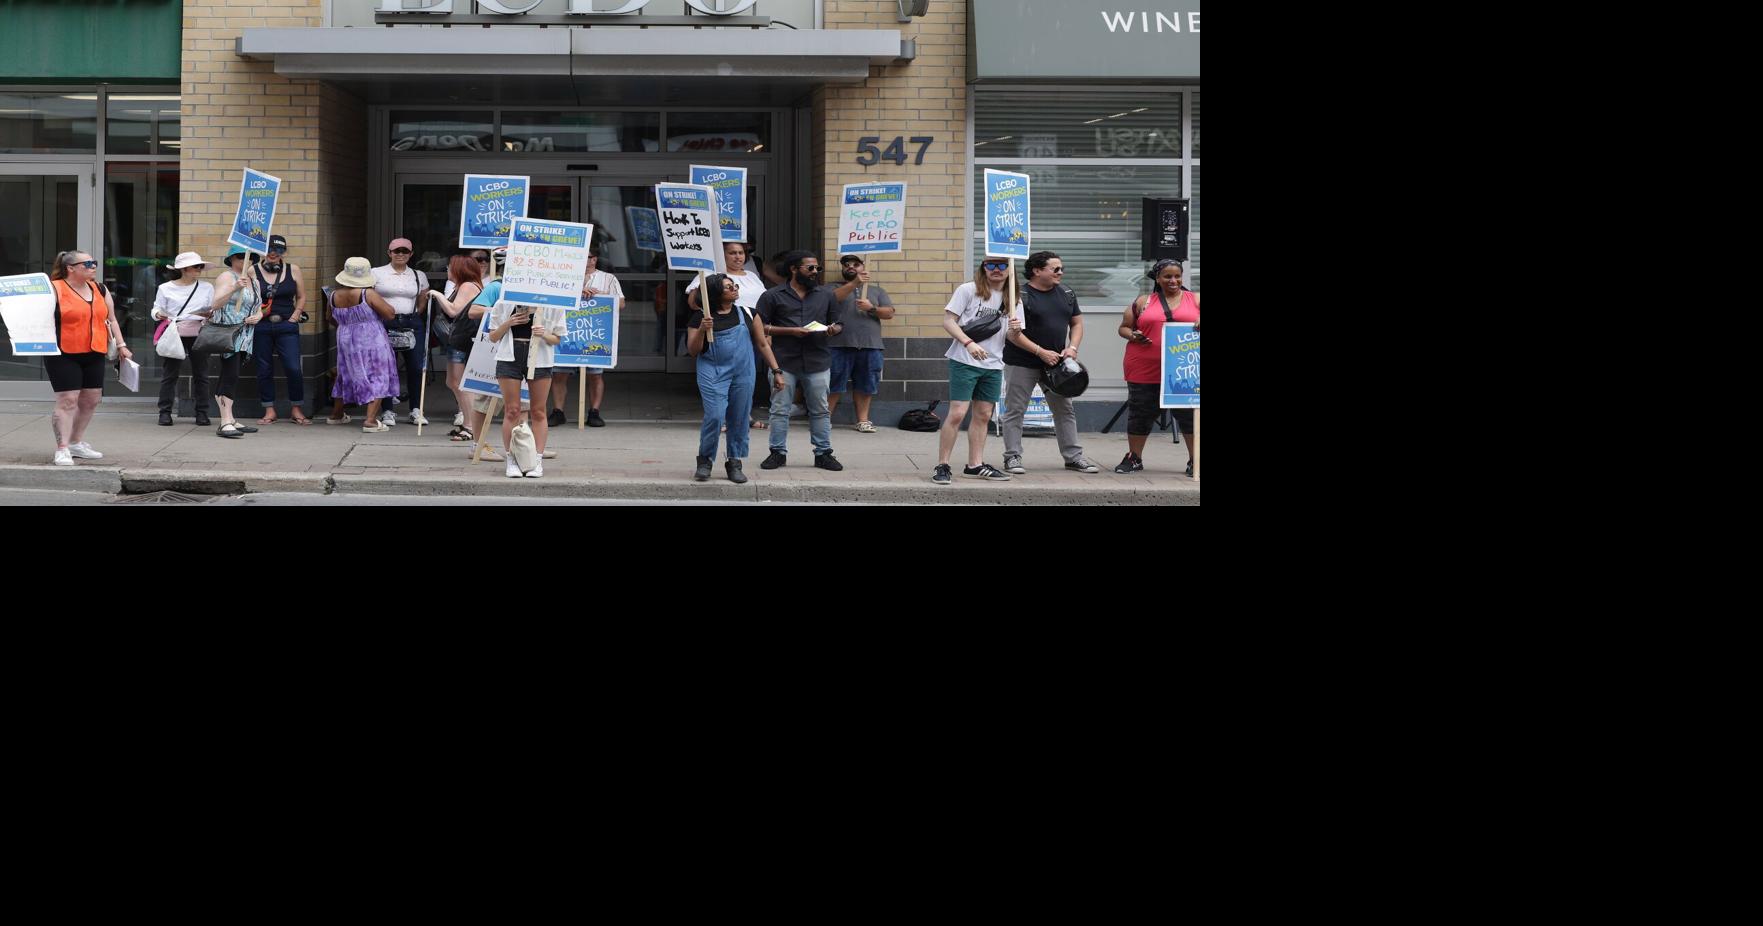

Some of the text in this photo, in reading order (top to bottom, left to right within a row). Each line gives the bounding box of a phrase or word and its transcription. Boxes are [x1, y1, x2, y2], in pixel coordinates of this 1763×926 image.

[856, 136, 934, 166] 547
[702, 172, 726, 183] LCBO
[250, 181, 267, 189] LCBO
[480, 181, 509, 193] LCBO
[995, 178, 1017, 191] LCBO
[245, 190, 275, 198] WORKERS
[470, 187, 523, 202] WORKERS
[663, 191, 673, 199] ON
[714, 190, 724, 201] N
[860, 187, 886, 195] STRIKE!
[991, 187, 1025, 202] WORKERS
[250, 198, 261, 210] ON
[488, 198, 504, 211] ON
[1003, 199, 1016, 213] ON
[242, 209, 267, 224] STRIKE
[476, 210, 516, 225] STRIKE
[663, 211, 690, 226] Honk
[690, 213, 702, 225] To
[849, 209, 895, 220] Keep
[856, 220, 898, 231] LCBO
[995, 213, 1024, 229] STRIKE
[519, 224, 566, 236] ON STRIKE!
[666, 228, 695, 239] Support
[848, 230, 898, 242] Public
[513, 244, 550, 258] LCBO
[670, 241, 702, 251] Workers
[504, 276, 575, 290] KEEP IT PUBLIC!
[580, 299, 597, 309] BO
[576, 316, 593, 329] ON
[1177, 331, 1200, 343] LCB
[1175, 363, 1200, 381] STRI
